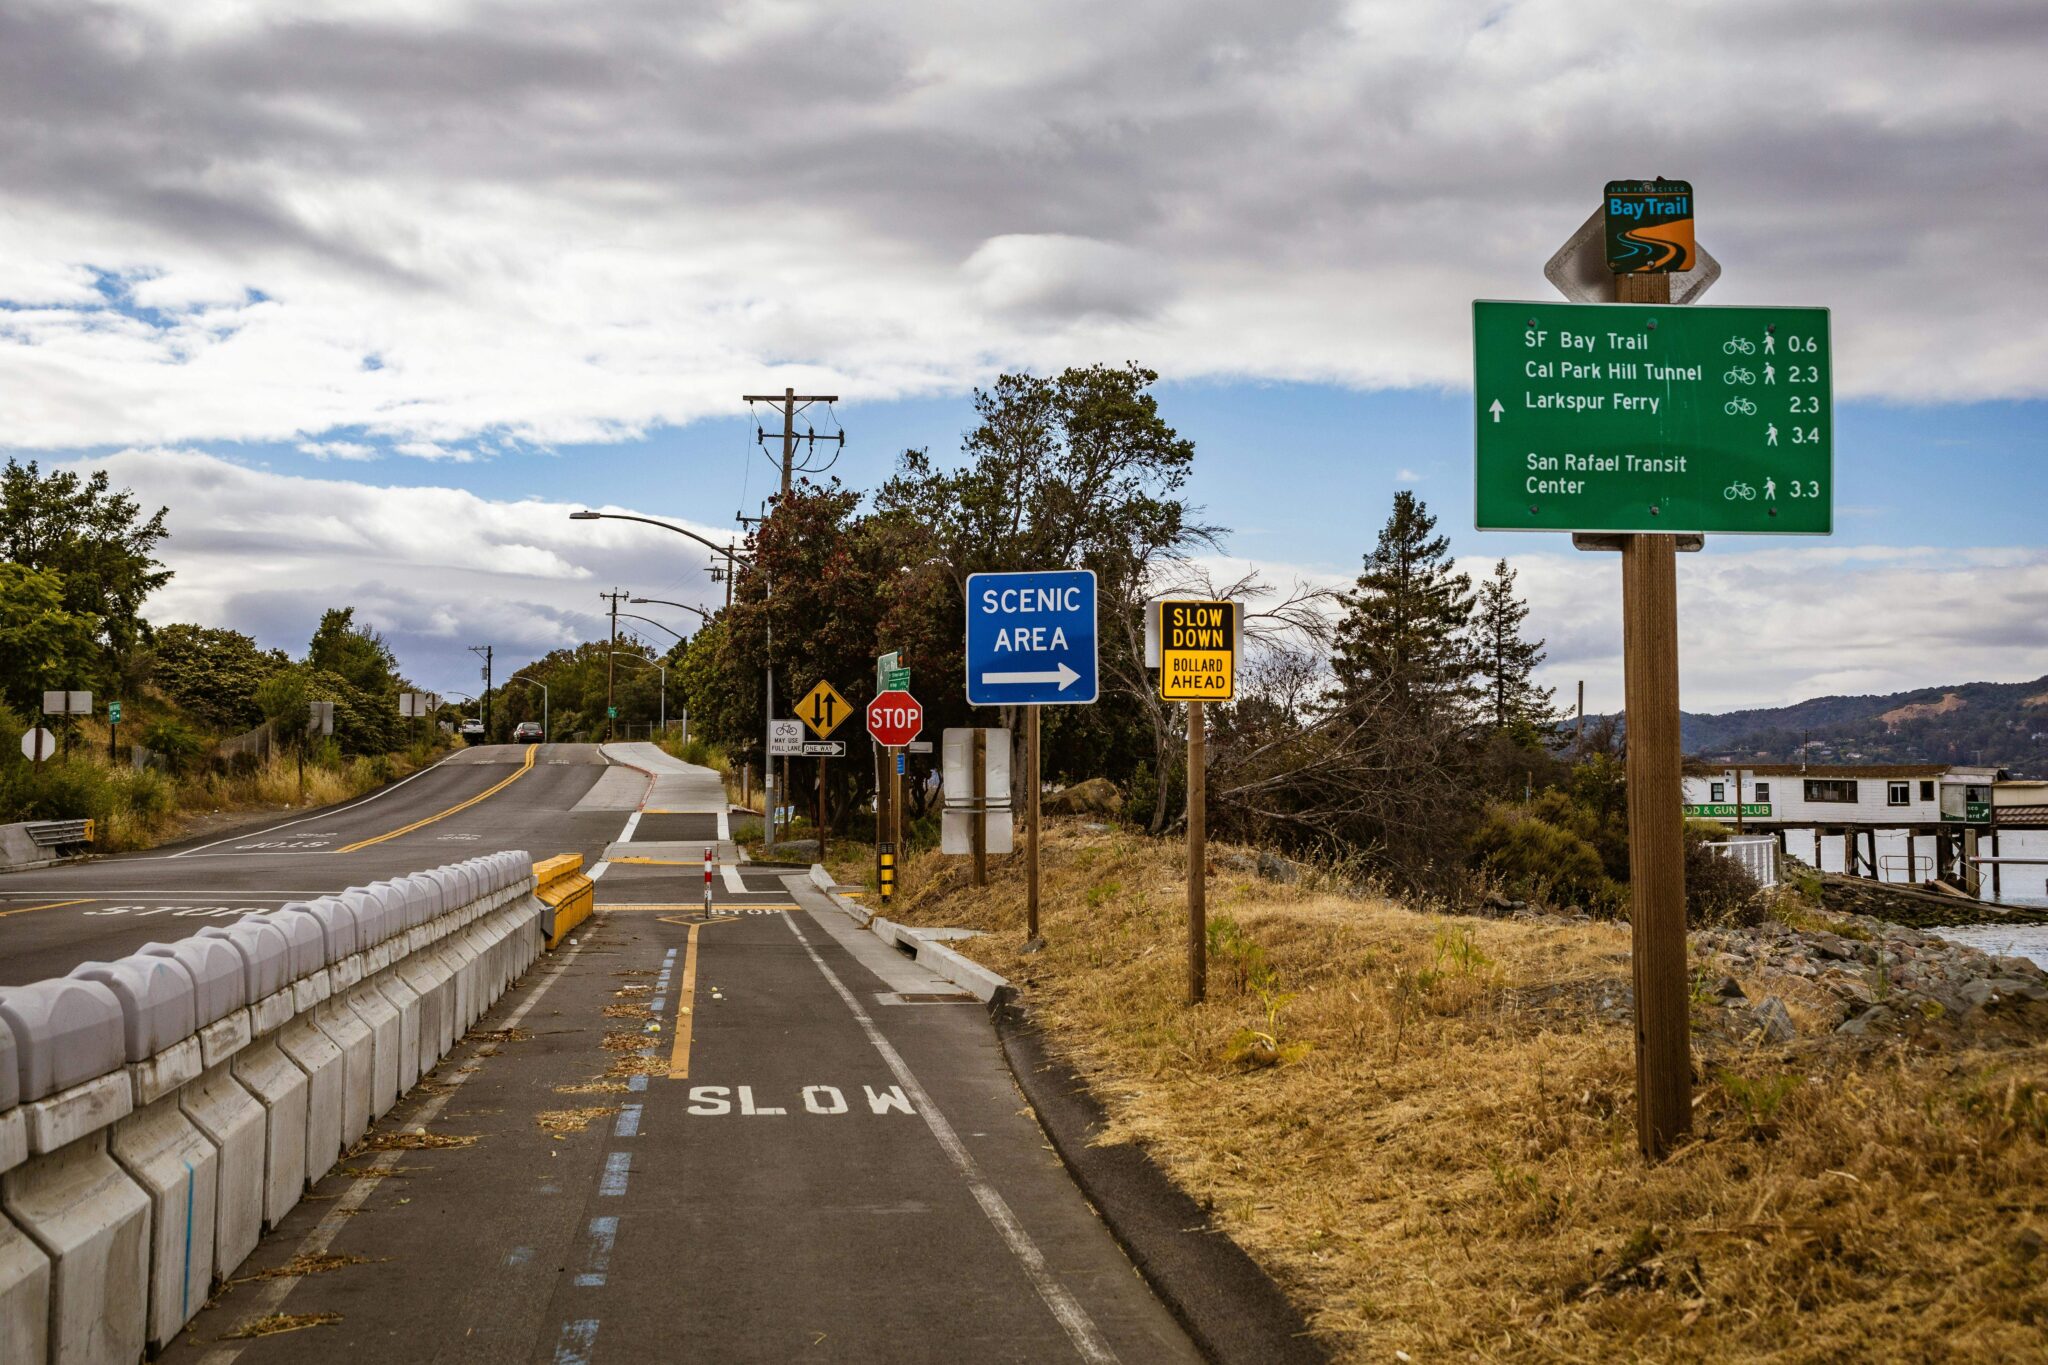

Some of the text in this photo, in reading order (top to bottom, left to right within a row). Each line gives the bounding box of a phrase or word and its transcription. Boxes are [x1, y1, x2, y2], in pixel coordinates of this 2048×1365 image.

[1610, 196, 1688, 220] Bay Trail
[1525, 330, 1649, 353] SF Bay Trail
[1788, 335, 1817, 353] 0.6
[1525, 360, 1703, 381] Cal Park Hill Tunnel
[1789, 366, 1819, 383] 2.3
[1525, 391, 1660, 415] Larkspur Ferry
[1789, 396, 1820, 413] 2.3
[1791, 426, 1820, 444] 3.4
[1527, 452, 1688, 473] San Rafael Transit
[1526, 476, 1585, 494] Center
[1789, 480, 1820, 498] 3.3
[982, 587, 1081, 614] SCENIC
[1172, 608, 1223, 628] SLOW
[993, 627, 1069, 652] AREA
[1172, 629, 1224, 648] DOWN
[1173, 658, 1223, 672] BOLLARD
[1171, 675, 1225, 689] AHEAD
[871, 708, 919, 729] STOP
[1703, 806, 1711, 815] &
[1713, 806, 1737, 815] GUN
[1741, 806, 1769, 815] CLUB
[83, 905, 271, 917] STOP
[686, 1085, 918, 1115] SLOW
